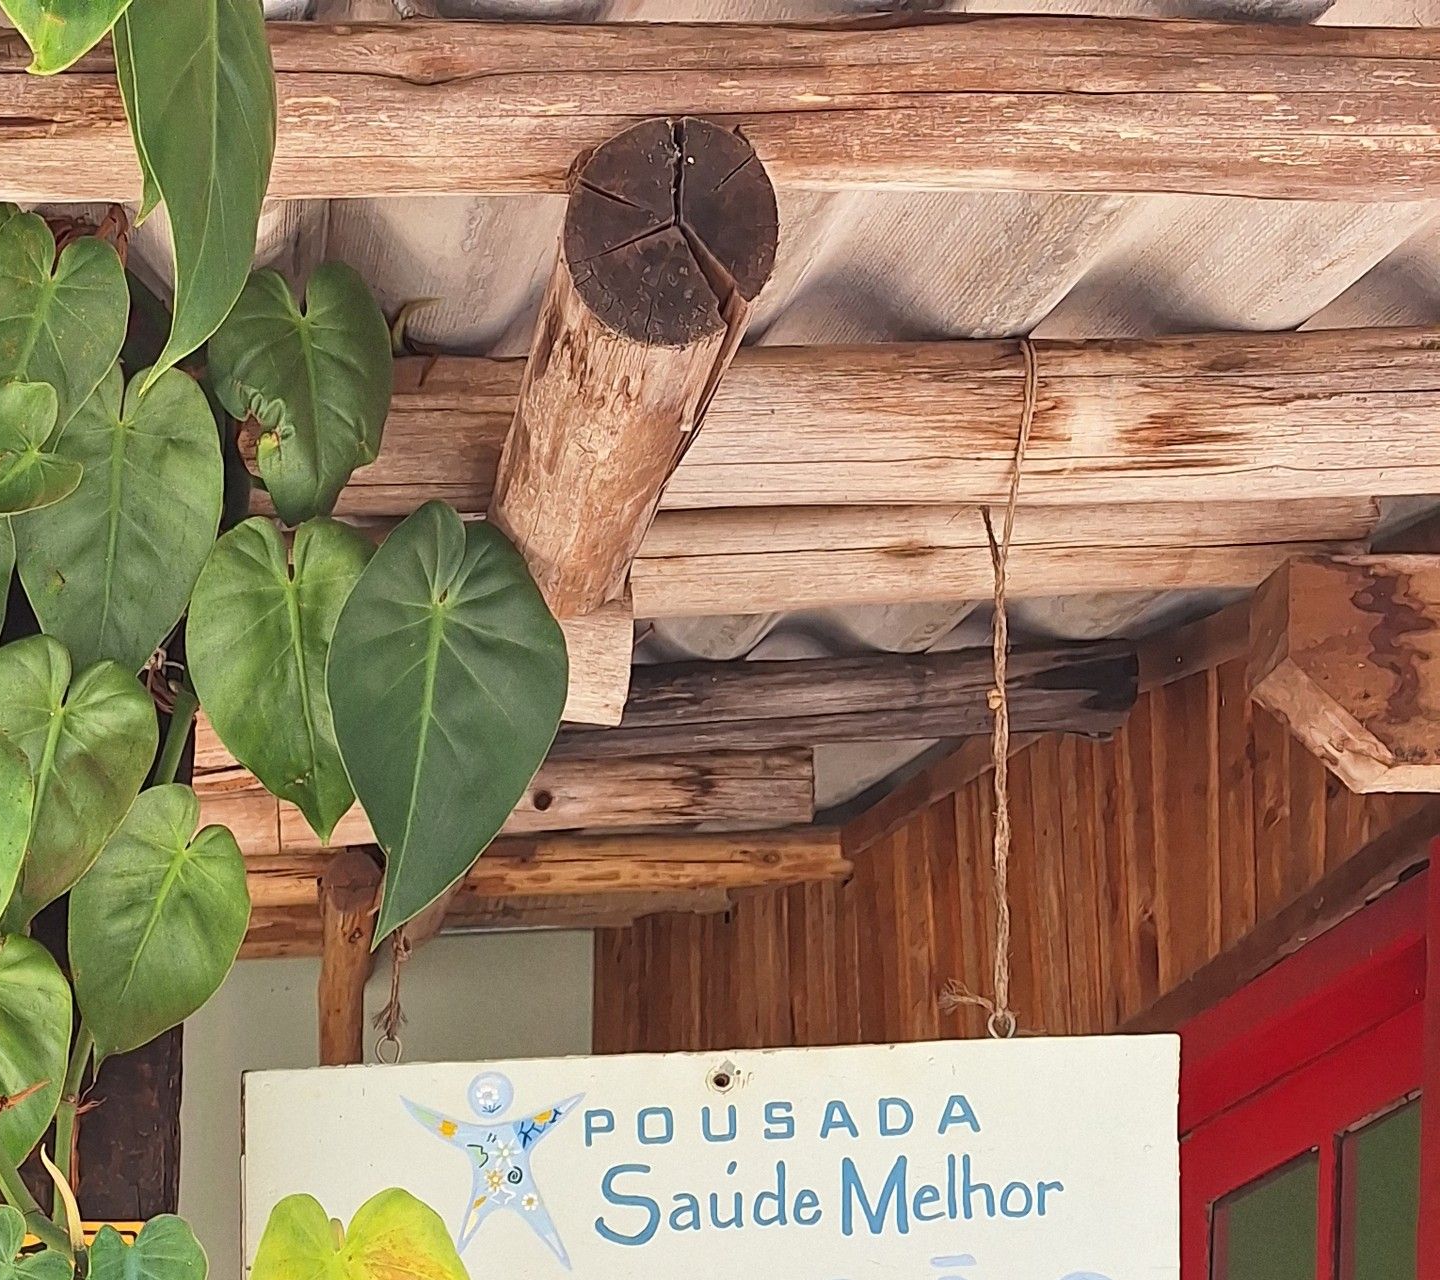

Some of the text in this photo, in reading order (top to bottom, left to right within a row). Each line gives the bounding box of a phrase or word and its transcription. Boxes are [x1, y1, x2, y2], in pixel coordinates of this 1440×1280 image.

[584, 1094, 982, 1147] POUSADA
[594, 1152, 1065, 1246] Saúde Melhor
